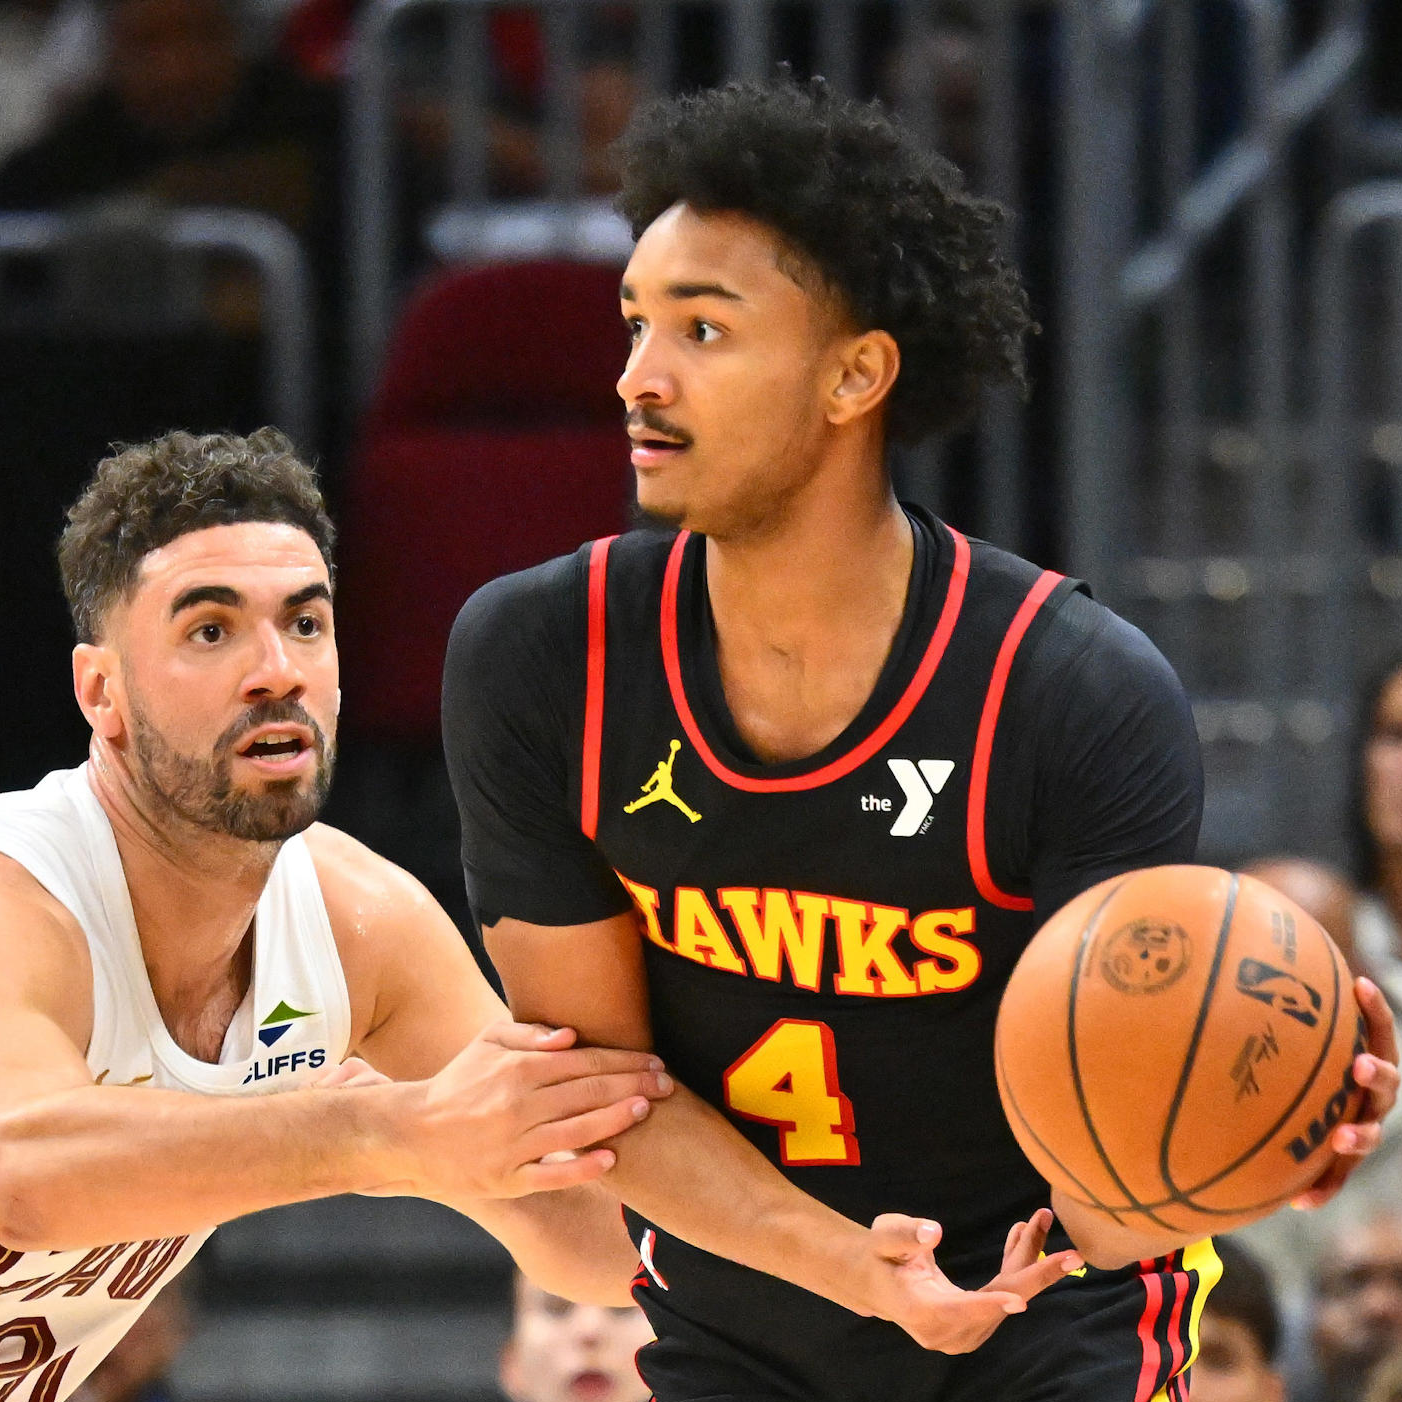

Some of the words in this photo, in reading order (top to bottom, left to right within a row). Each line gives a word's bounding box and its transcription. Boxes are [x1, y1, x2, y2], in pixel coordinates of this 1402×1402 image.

[860, 794, 892, 812] the
[918, 815, 935, 836] YMCA
[722, 1017, 861, 1167] 4
